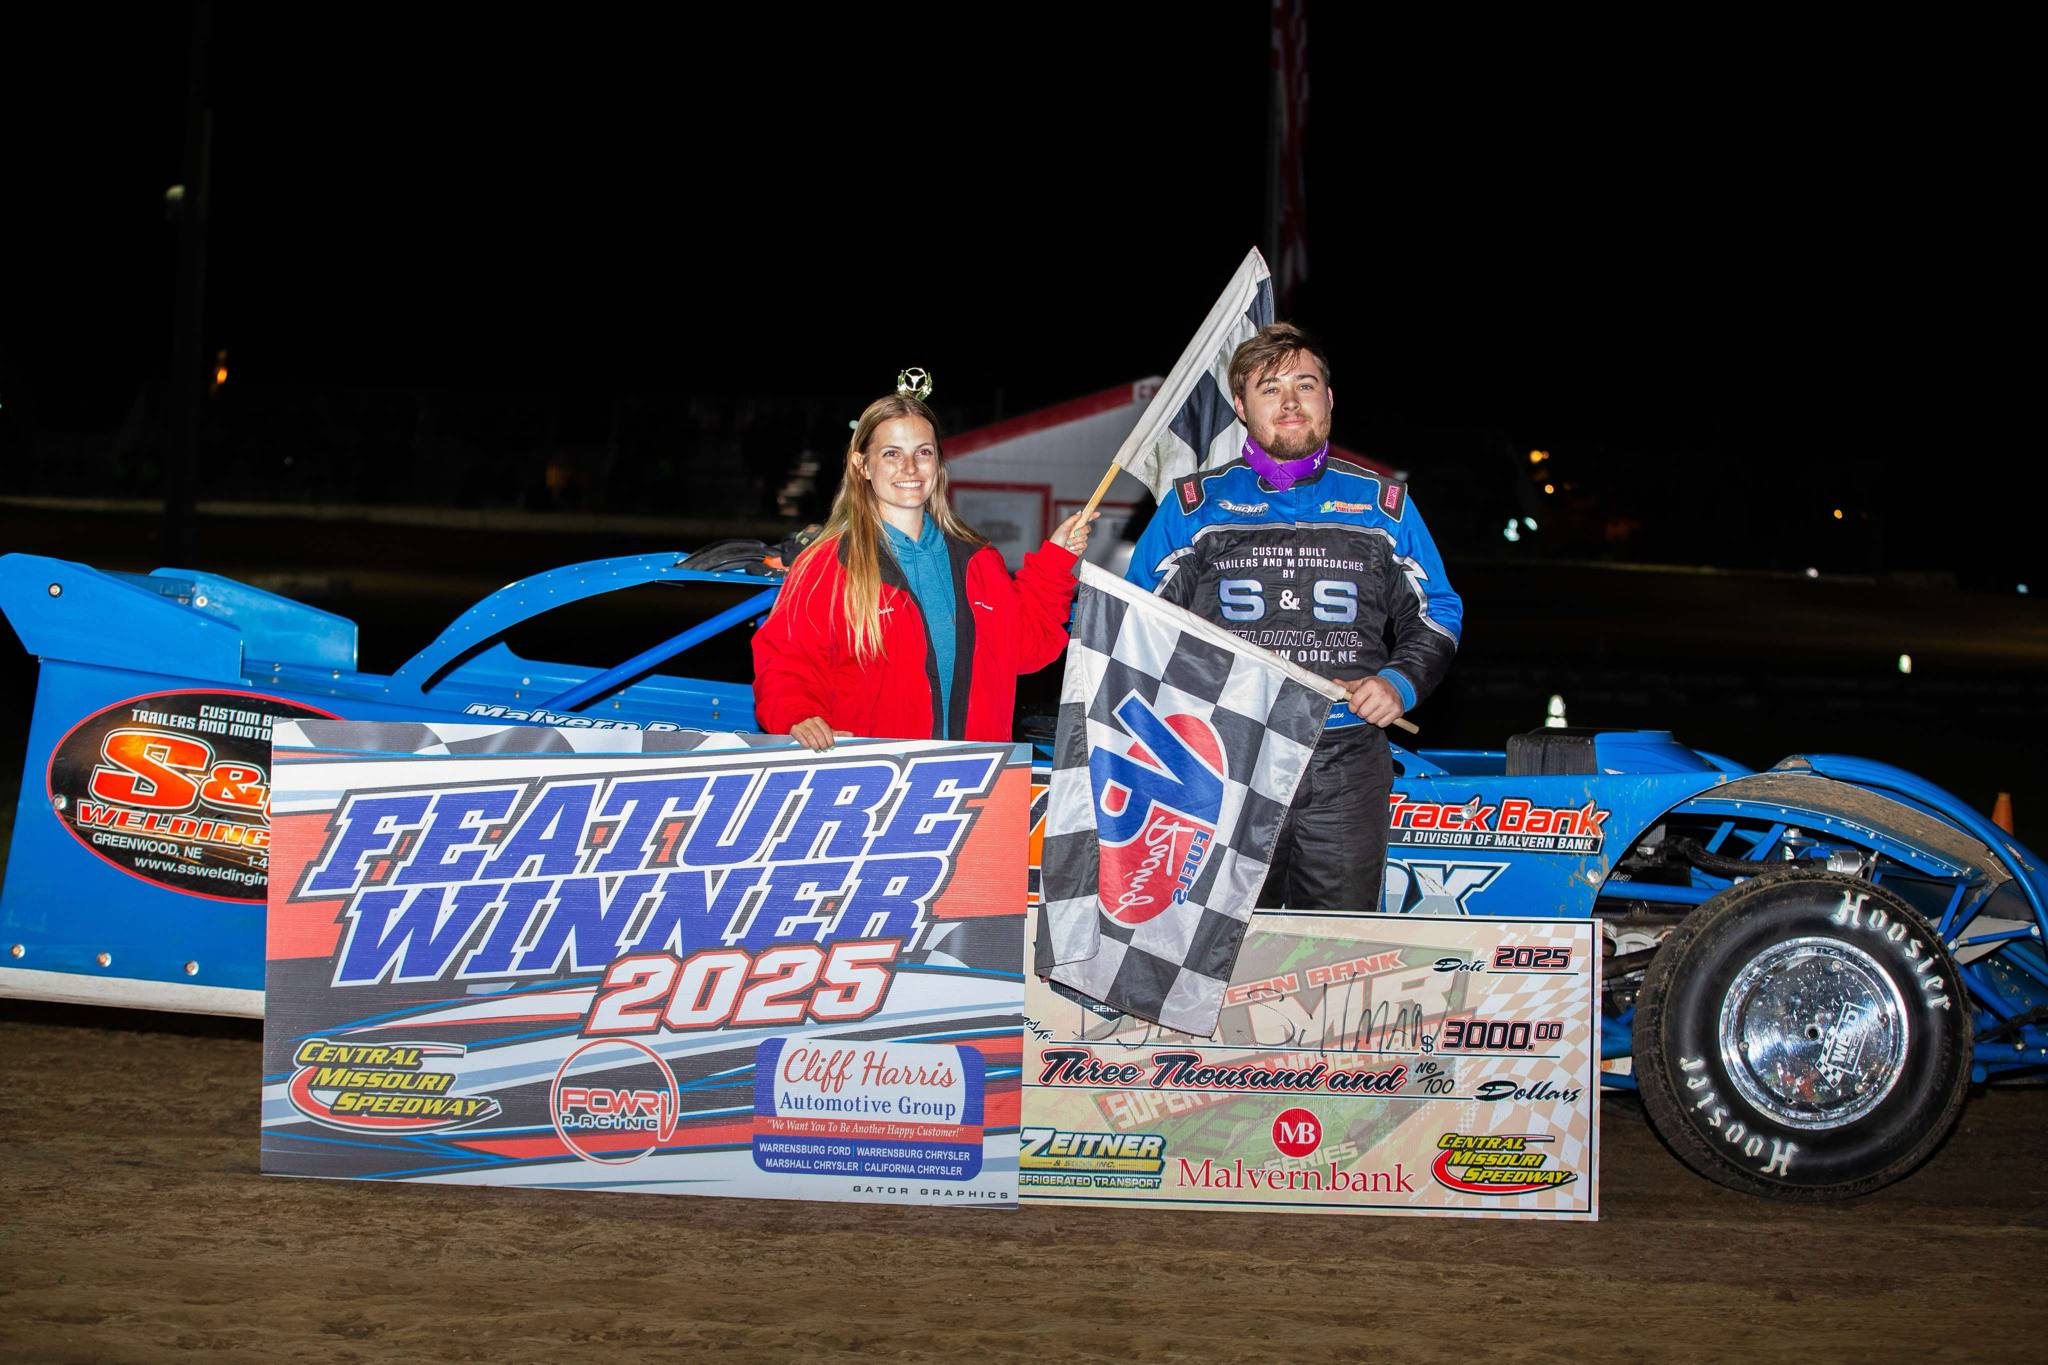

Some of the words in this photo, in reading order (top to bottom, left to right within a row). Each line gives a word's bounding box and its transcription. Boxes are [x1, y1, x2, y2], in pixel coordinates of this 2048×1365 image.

[1252, 547, 1293, 557] CUSTOM
[1299, 547, 1326, 557] BUILT
[1213, 558, 1258, 571] TRAILERS
[1262, 558, 1282, 567] AND
[1282, 569, 1295, 579] BY
[1218, 578, 1266, 622] S
[1279, 588, 1301, 611] &
[1312, 579, 1358, 624] S
[1230, 630, 1322, 648] ELDING,
[1325, 631, 1364, 647] INC.
[1338, 650, 1357, 663] NE
[131, 708, 197, 730] TRAILERS
[198, 720, 227, 735] AND
[229, 724, 272, 741] MOTO
[200, 705, 262, 724] CUSTOM
[297, 751, 1005, 898] FEATURE
[1497, 799, 1610, 837] Bank
[92, 832, 180, 856] GREENWOOD,
[184, 846, 203, 859] NE
[1402, 831, 1411, 842] A
[1414, 831, 1472, 845] DIVISION
[1475, 833, 1491, 845] OF
[1494, 834, 1554, 848] MALVERN
[1555, 837, 1593, 850] BANK
[134, 856, 268, 885] www.ssweldingin
[246, 855, 268, 868] 1-4
[331, 851, 951, 988] WINNER
[1433, 957, 1486, 972] Date
[1494, 946, 1571, 969] 2025
[1831, 889, 1951, 1010] Hoosier
[1306, 950, 1404, 986] BANK
[585, 940, 901, 1034] 2025
[298, 1042, 421, 1066] CENTRAL
[1420, 1035, 1434, 1054] $
[311, 1067, 450, 1091] MISSOURI
[783, 1048, 856, 1093] Cliff
[861, 1051, 957, 1088] Harris
[1040, 1048, 1144, 1086] Three
[1150, 1051, 1328, 1091] Thousand
[1328, 1064, 1407, 1093] and
[333, 1092, 486, 1117] SPEEDWAY
[1475, 1080, 1582, 1105] Dollars
[779, 1092, 892, 1115] Automotive
[898, 1096, 956, 1120] Group
[1680, 1057, 1799, 1177] Hoosier
[561, 1115, 659, 1131] RACING
[787, 1120, 808, 1132] Want
[811, 1121, 825, 1132] You
[828, 1122, 838, 1132] To
[840, 1122, 850, 1133] Be
[852, 1123, 885, 1135] Another
[887, 1125, 915, 1138] Happy
[1278, 1121, 1317, 1145] MB
[759, 1143, 825, 1155] WARRENSBURG
[827, 1146, 851, 1156] FORD
[857, 1147, 923, 1159] WARRENSBURG
[925, 1150, 970, 1161] CHRYSLER
[1020, 1128, 1164, 1158] ZEITNER
[1438, 1133, 1525, 1150] CENTRAL
[765, 1158, 812, 1169] MARSHALL
[813, 1160, 859, 1171] CHRYSLER
[864, 1162, 915, 1173] CALIFORNIA
[917, 1165, 962, 1175] CHRYSLER
[1448, 1151, 1545, 1167] MISSOURI
[1019, 1175, 1091, 1186] EFRIGERATED
[1094, 1177, 1161, 1189] TRANSPORT
[1178, 1158, 1415, 1193] Malvern.bank
[1463, 1167, 1569, 1184] SPEEDWAY
[853, 1185, 909, 1194] GATOR
[920, 1188, 1008, 1199] GRAPHICS
